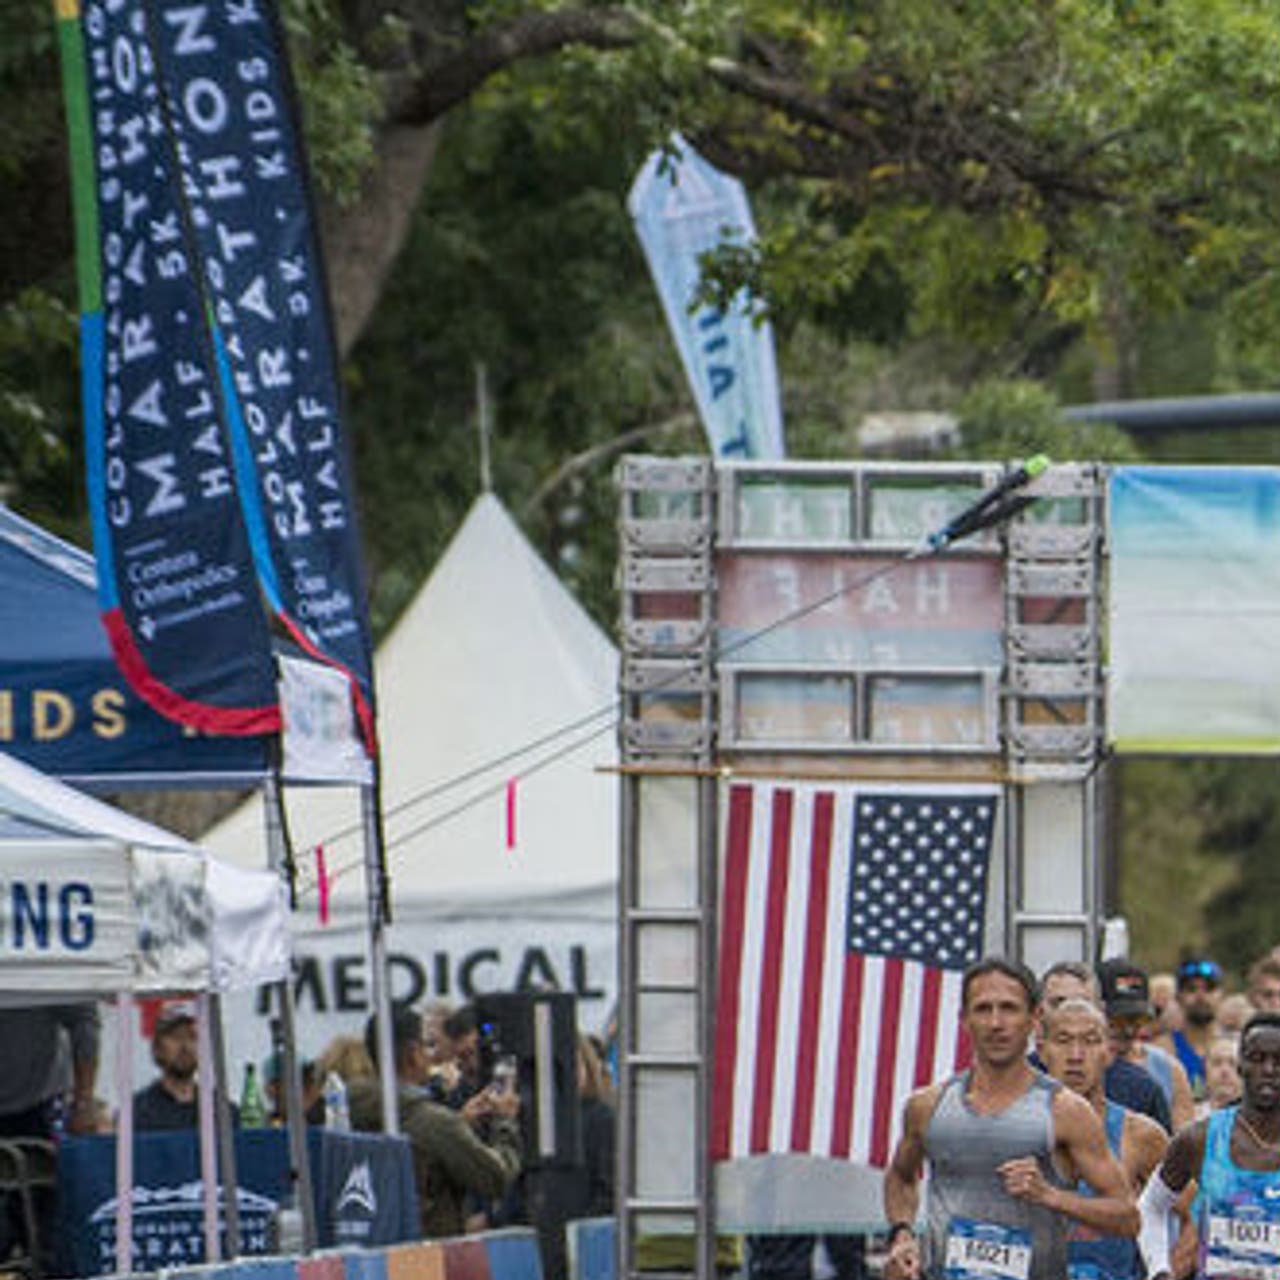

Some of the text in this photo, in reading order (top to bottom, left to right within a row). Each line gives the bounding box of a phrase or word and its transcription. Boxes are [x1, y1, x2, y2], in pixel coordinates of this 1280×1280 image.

[237, 56, 289, 179] KIDS
[150, 212, 187, 279] 5K
[163, 6, 312, 536] MARATHON
[174, 360, 232, 498] HALF
[297, 396, 346, 530] HALF
[11, 881, 95, 951] NG
[255, 945, 605, 1016] MEDICAL
